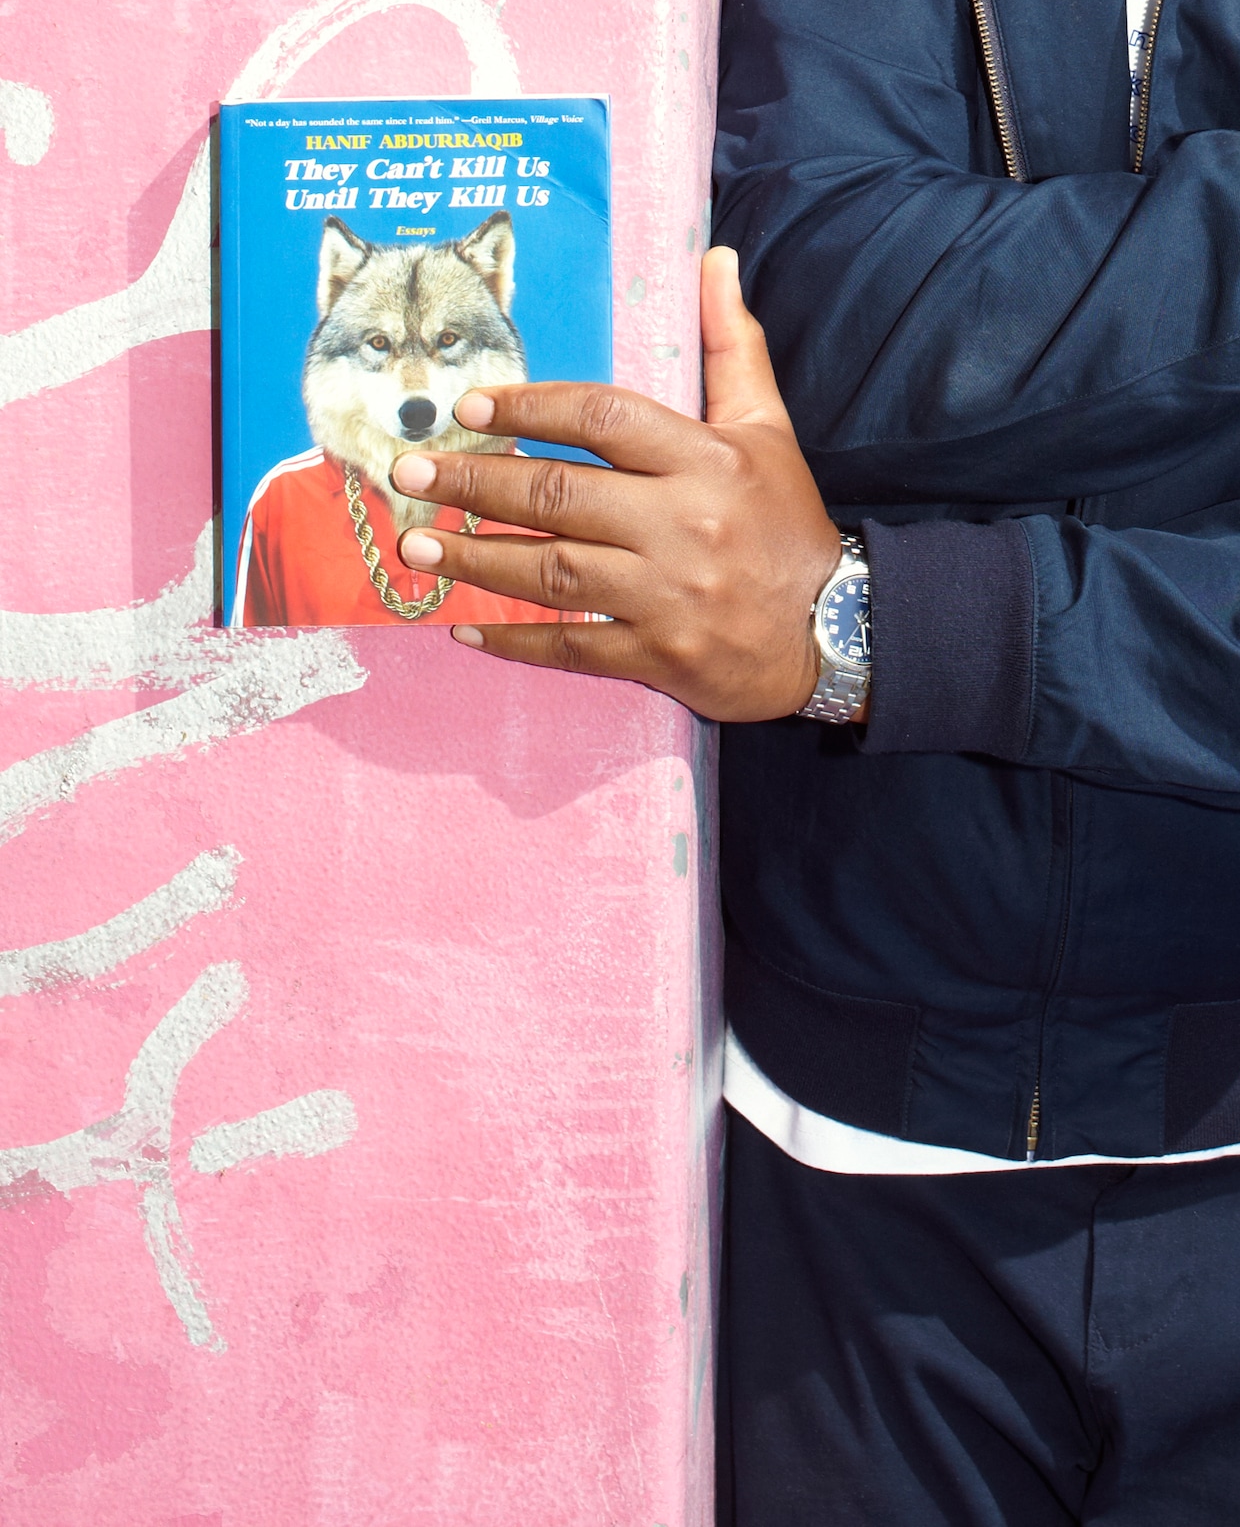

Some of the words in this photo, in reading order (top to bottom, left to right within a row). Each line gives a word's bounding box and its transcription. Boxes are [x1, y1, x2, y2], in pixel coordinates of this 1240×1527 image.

[275, 118, 291, 129] day
[292, 118, 308, 127] has
[308, 117, 345, 127] sounded
[346, 117, 360, 126] the
[385, 117, 407, 126] since
[415, 116, 434, 125] read
[493, 115, 528, 125] Marcus,
[530, 114, 559, 126] Village
[561, 115, 583, 123] Voice
[306, 135, 372, 150] HANIF
[380, 133, 522, 150] ABDURRAQIB
[285, 159, 359, 187] They
[366, 156, 444, 179] Can’t
[448, 155, 507, 179] Kill
[516, 156, 551, 178] Us
[286, 185, 358, 210] Until
[369, 187, 441, 213] They
[447, 184, 507, 208] Kill
[515, 185, 551, 207] Us
[396, 225, 436, 237] Essays
[827, 607, 839, 620] 3
[849, 645, 863, 657] 12
